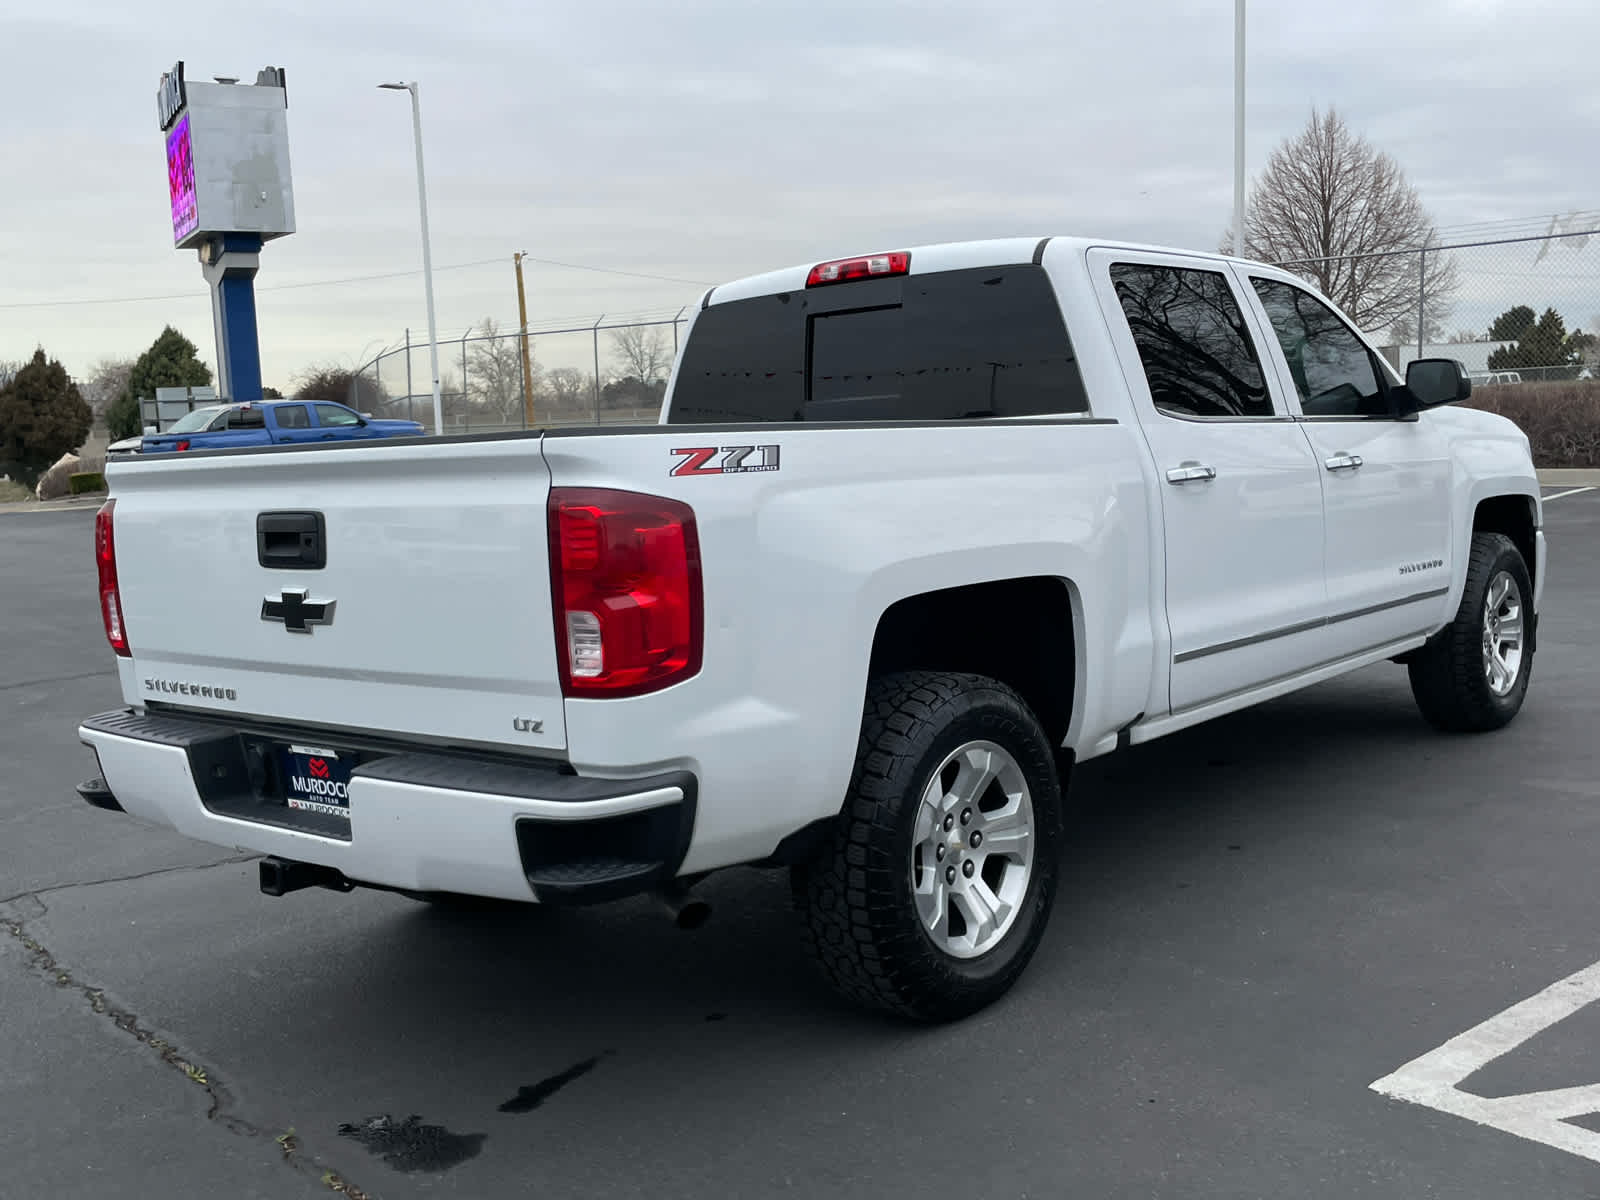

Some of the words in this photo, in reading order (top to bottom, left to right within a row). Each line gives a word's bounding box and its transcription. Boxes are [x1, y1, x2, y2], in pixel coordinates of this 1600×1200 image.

[670, 445, 780, 477] Z71
[1399, 560, 1443, 574] SILVERADO
[144, 679, 237, 700] SILVERADO
[513, 717, 544, 733] LTZ
